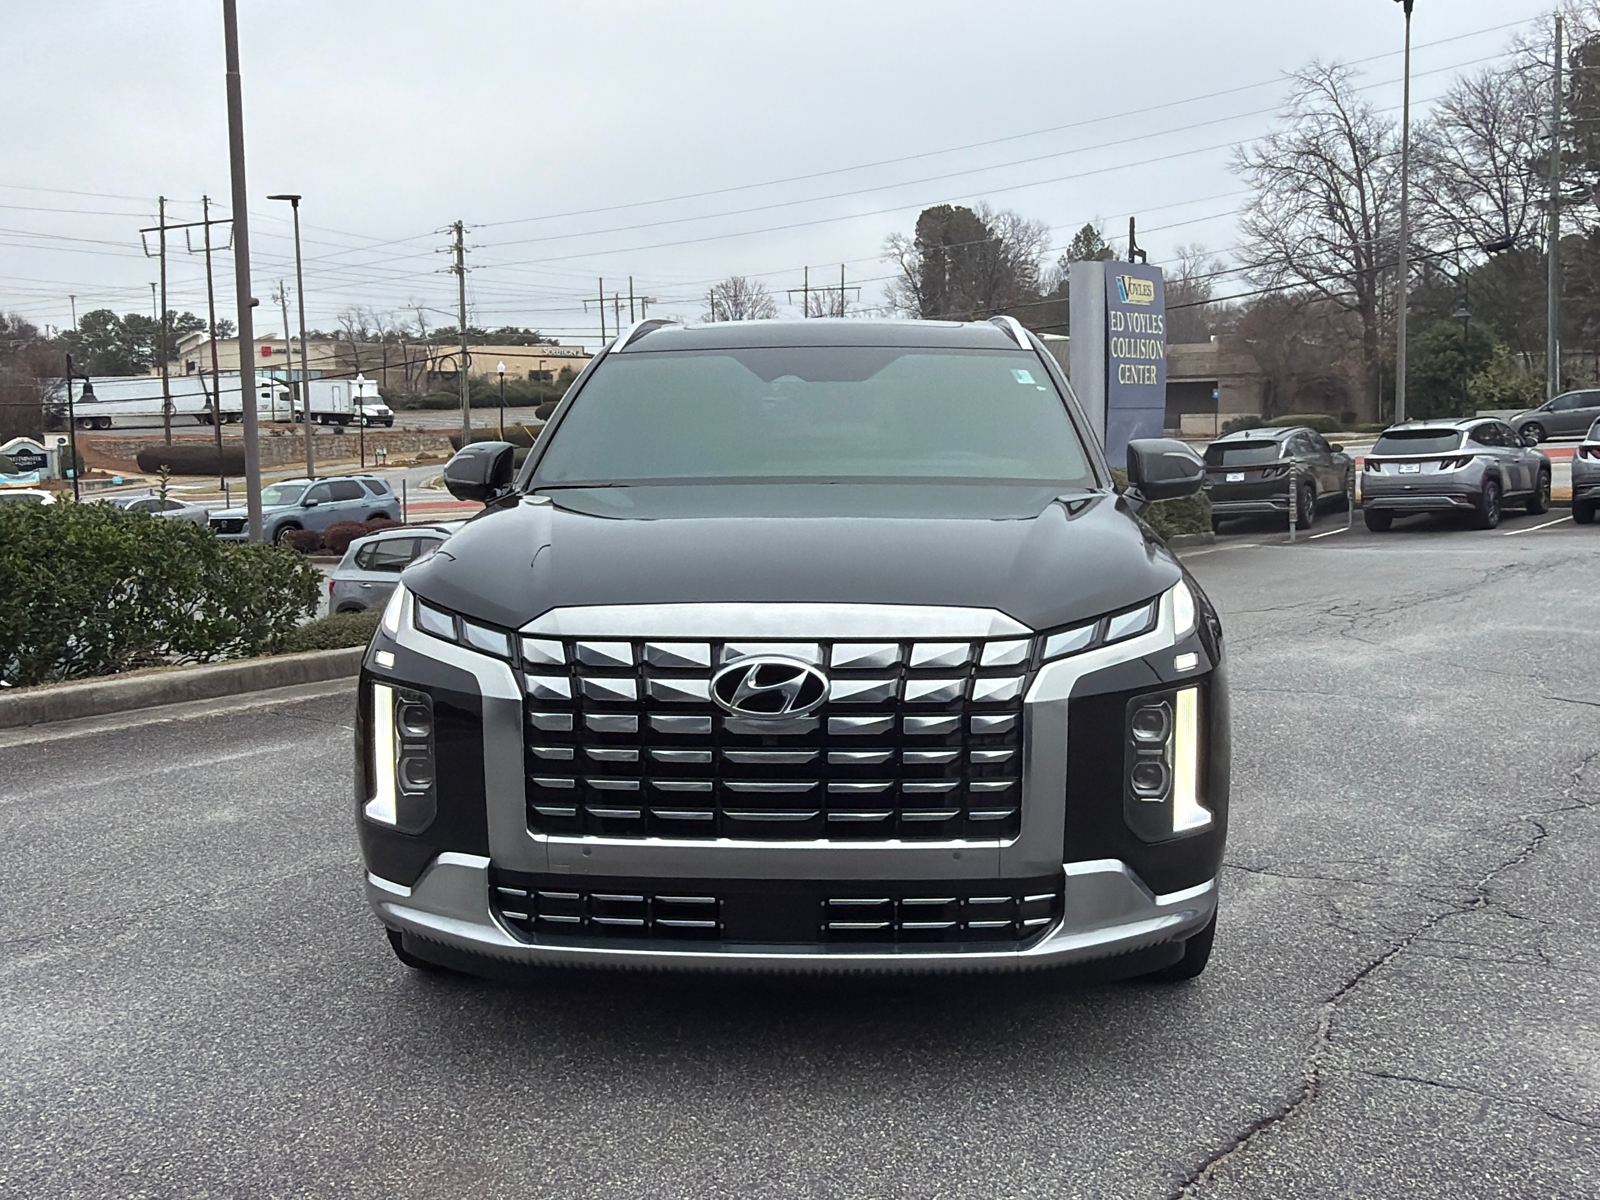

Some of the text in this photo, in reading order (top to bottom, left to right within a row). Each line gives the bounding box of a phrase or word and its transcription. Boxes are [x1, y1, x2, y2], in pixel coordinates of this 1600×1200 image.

[1121, 275, 1152, 299] VOYLES
[1110, 311, 1164, 334] ED VOYLES
[1111, 337, 1164, 359] COLLISION
[1118, 364, 1157, 384] CENTER
